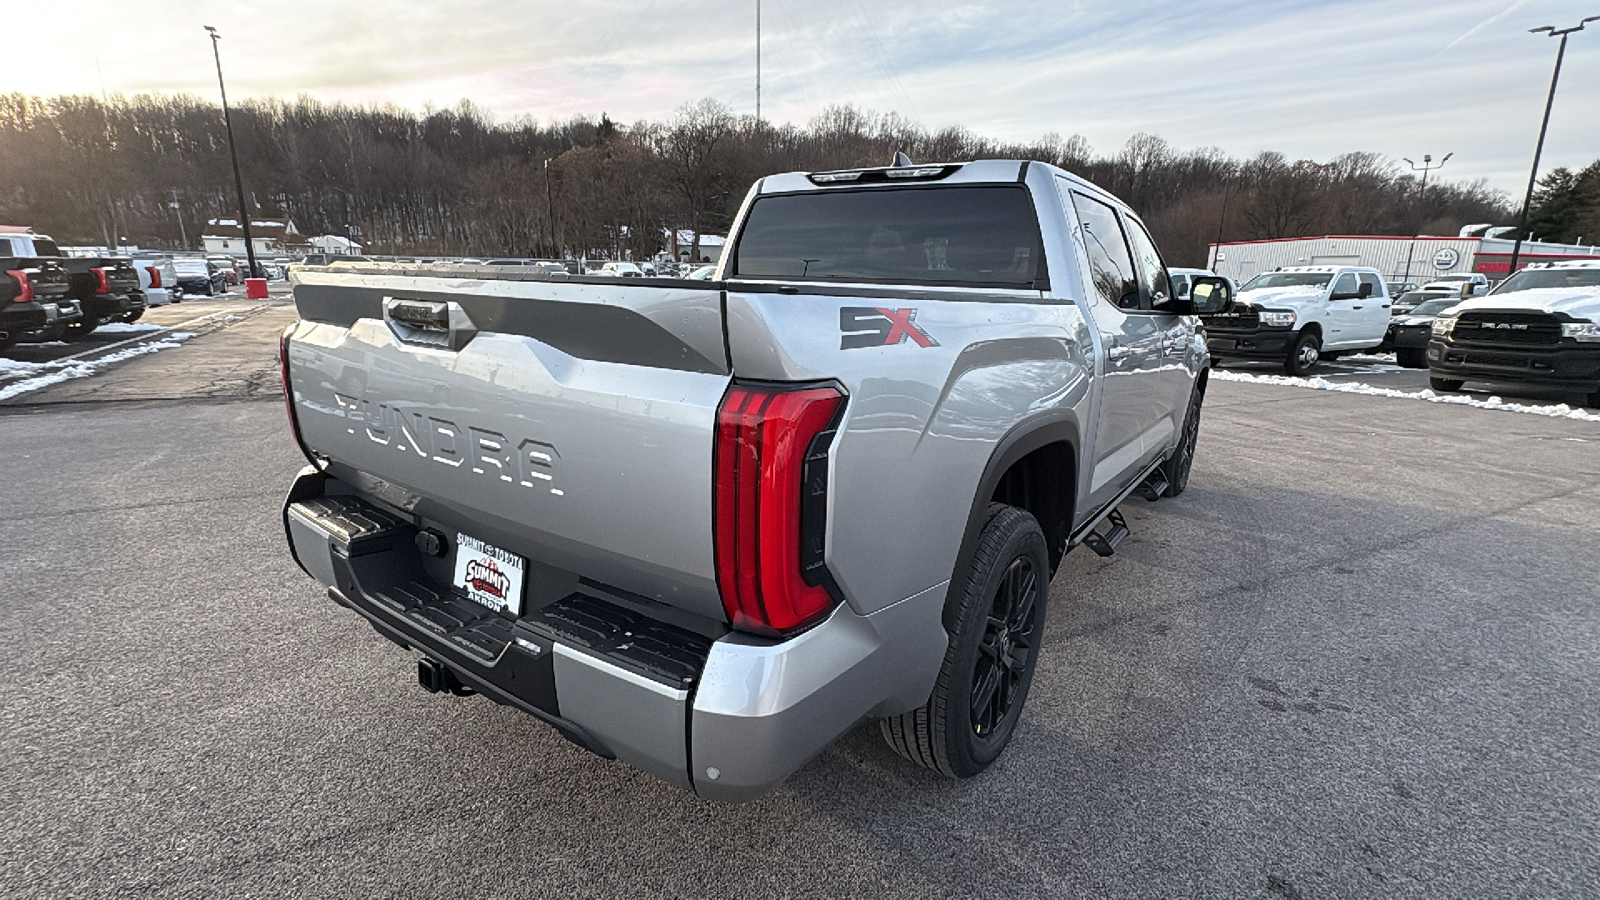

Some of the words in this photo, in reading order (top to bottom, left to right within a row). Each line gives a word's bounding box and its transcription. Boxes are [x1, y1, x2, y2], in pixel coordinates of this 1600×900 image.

[1481, 322, 1528, 330] RAM
[334, 392, 564, 496] TUNDRA
[456, 532, 485, 553] SUMMIT
[494, 547, 523, 570] TOYOTA
[466, 561, 510, 597] SUMMIT
[467, 592, 501, 613] AKRON
